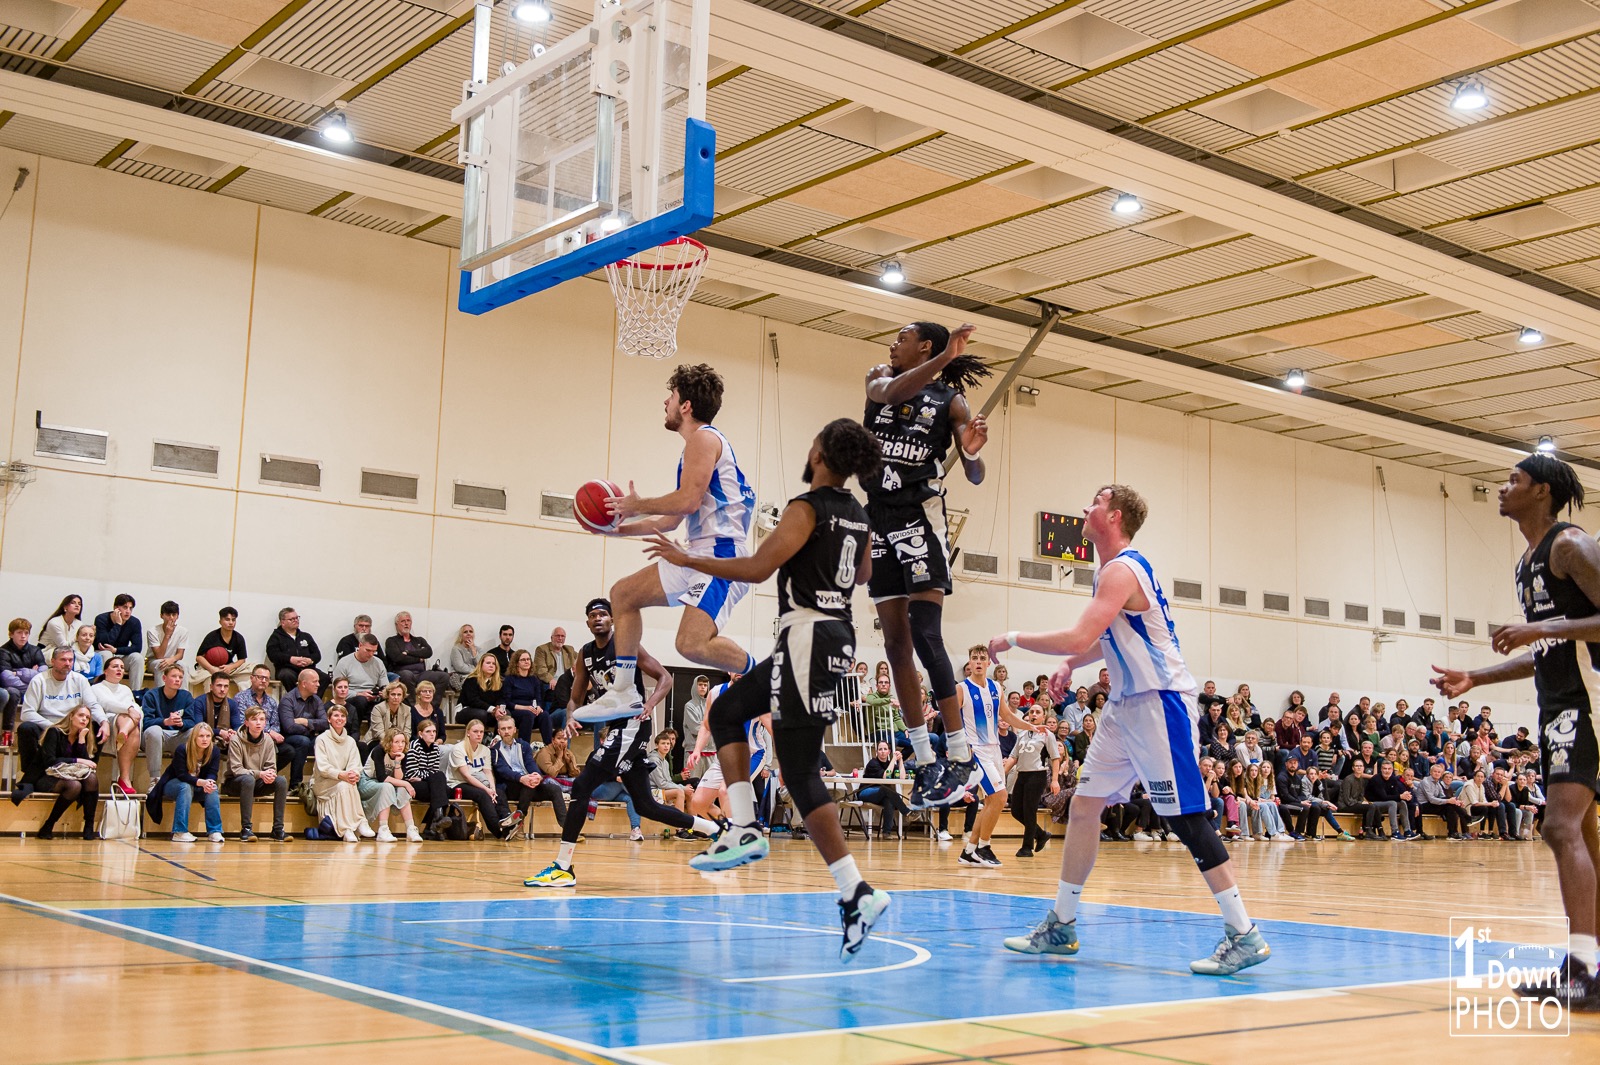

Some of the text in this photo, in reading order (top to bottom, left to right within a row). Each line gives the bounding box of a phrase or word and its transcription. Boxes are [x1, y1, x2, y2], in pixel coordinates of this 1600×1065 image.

[1048, 532, 1088, 546] H G
[835, 534, 857, 589] 0
[1018, 742, 1036, 754] 25
